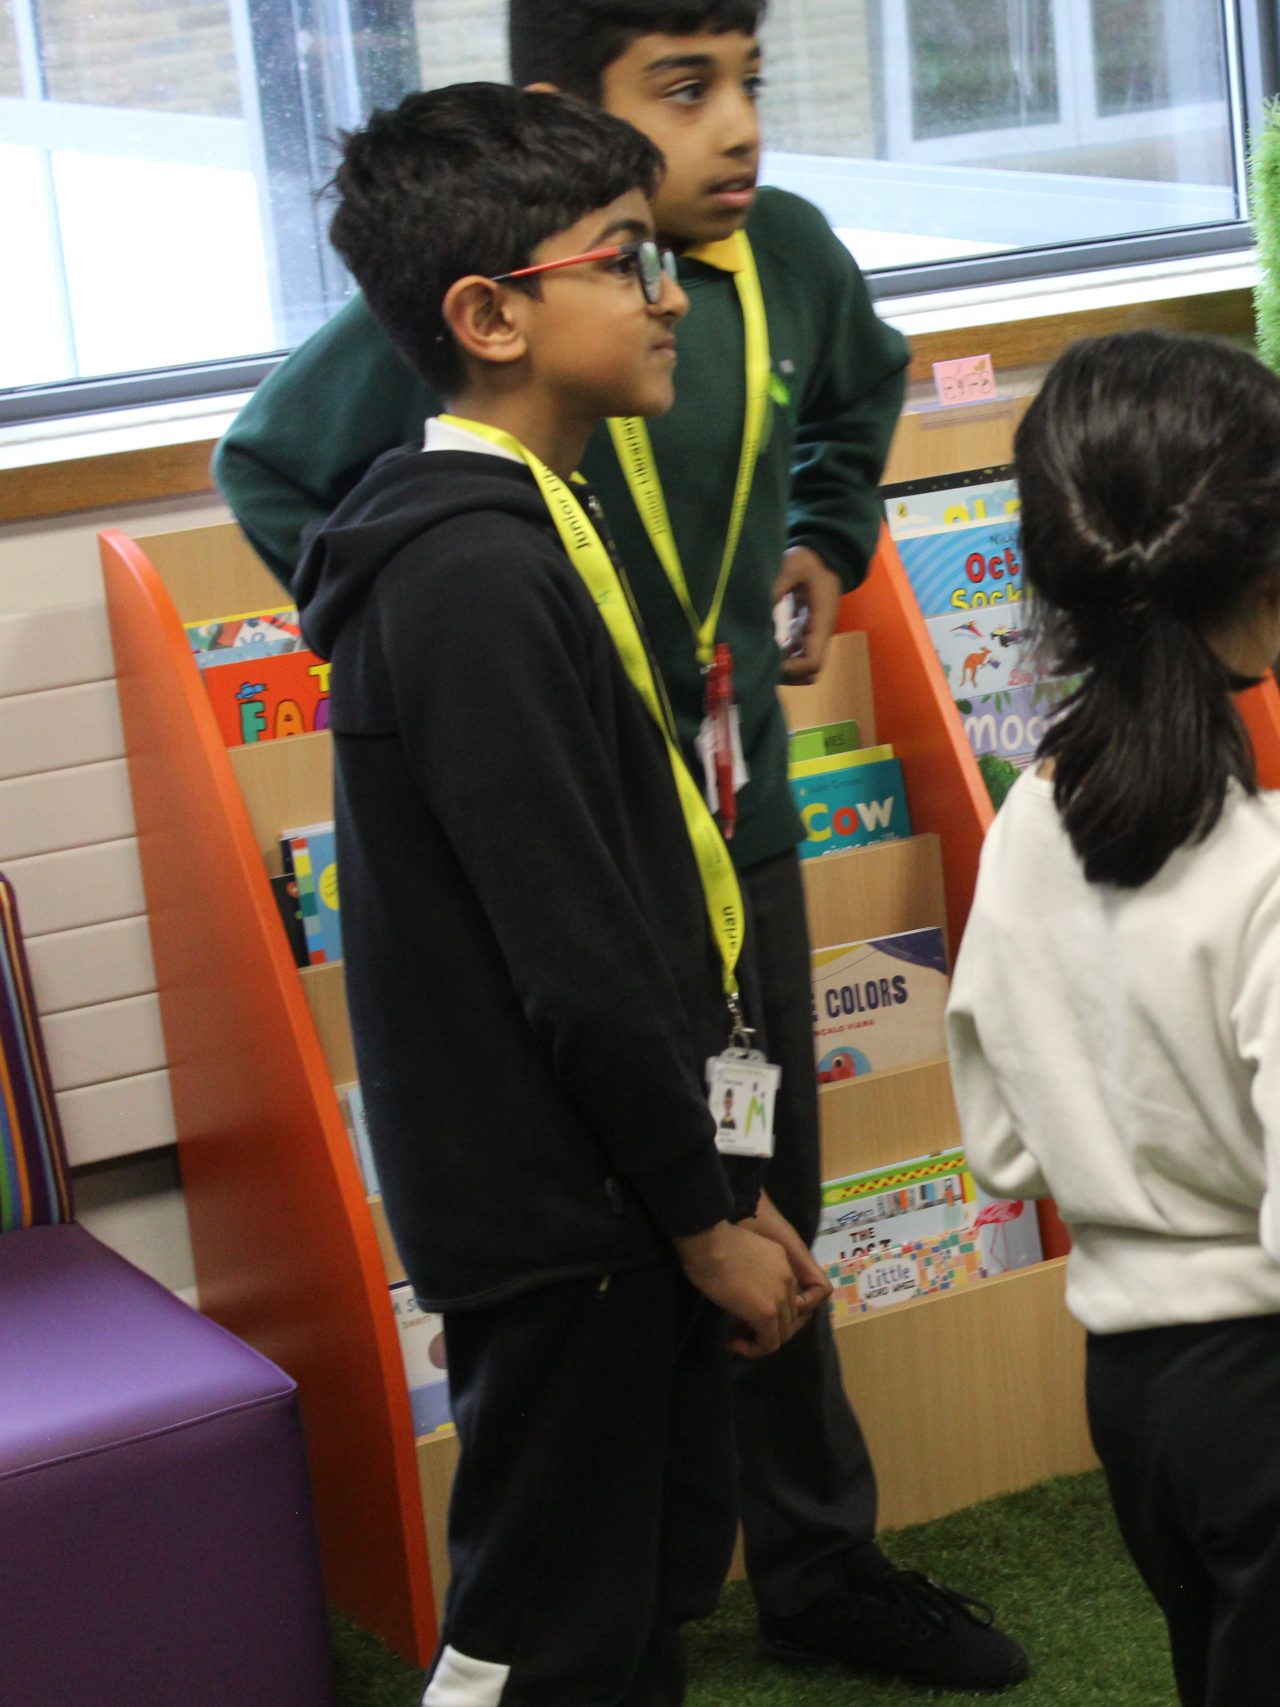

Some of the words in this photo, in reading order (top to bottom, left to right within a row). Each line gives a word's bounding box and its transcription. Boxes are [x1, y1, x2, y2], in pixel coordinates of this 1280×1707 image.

[558, 499, 591, 549] Junior
[965, 547, 1021, 584] Oct
[825, 974, 908, 1019] COLORS
[849, 1227, 876, 1243] THE
[867, 1264, 911, 1290] Little
